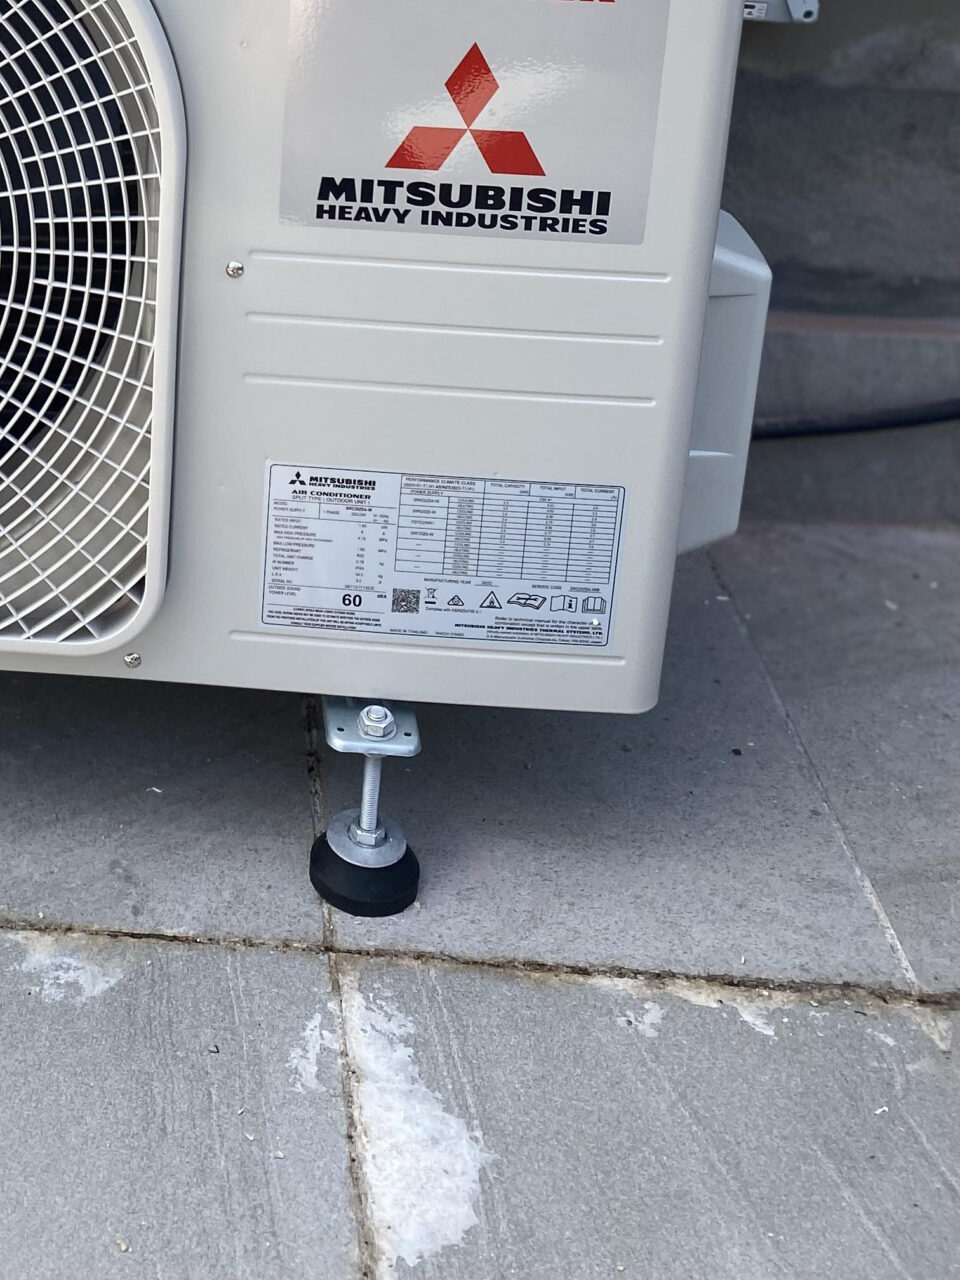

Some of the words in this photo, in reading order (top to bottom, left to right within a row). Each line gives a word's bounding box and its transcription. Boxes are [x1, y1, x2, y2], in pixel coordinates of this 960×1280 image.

[316, 176, 611, 216] MITSUBISHI
[315, 204, 412, 225] HEAVY
[420, 209, 608, 235] INDUSTRIES
[309, 476, 376, 487] MITSUBISHI
[332, 483, 376, 491] INDUSTRIES
[310, 490, 372, 500] CONDITIONER
[342, 593, 362, 607] 60
